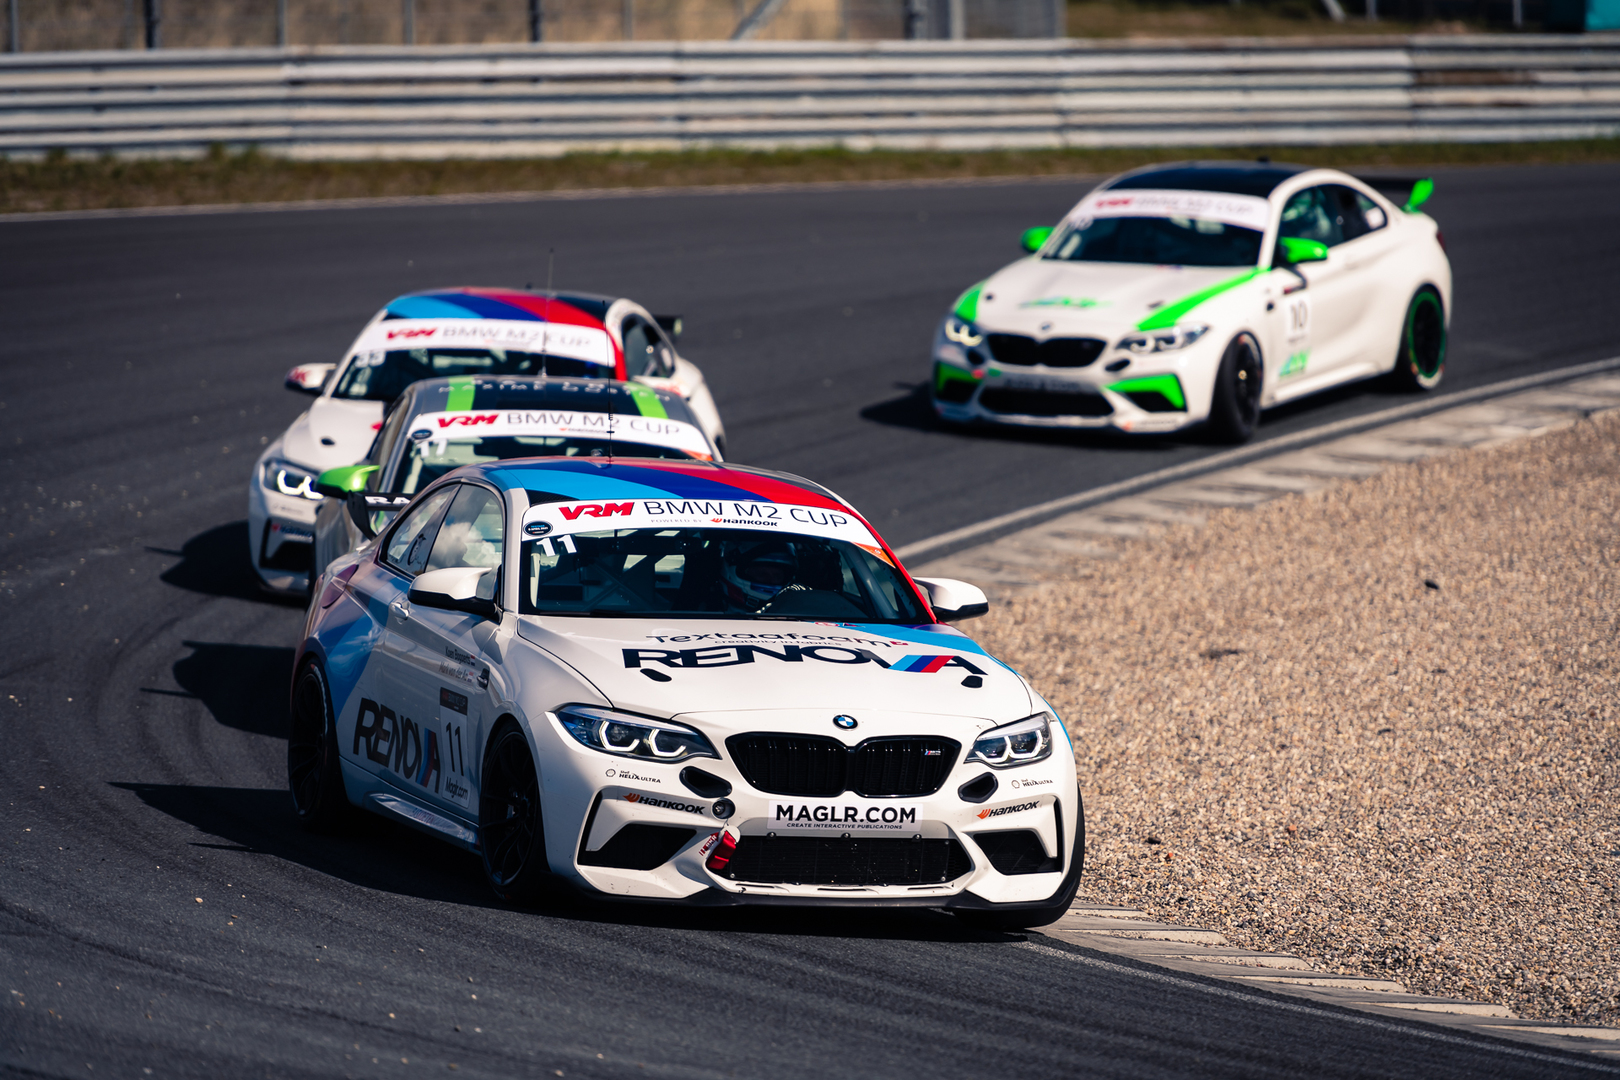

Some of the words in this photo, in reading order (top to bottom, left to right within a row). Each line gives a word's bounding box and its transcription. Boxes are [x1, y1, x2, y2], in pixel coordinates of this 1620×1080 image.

[442, 327, 501, 340] BMW
[546, 331, 592, 347] CUP
[437, 414, 499, 428] VRM
[507, 412, 574, 425] BMW
[583, 414, 621, 430] M2
[630, 418, 680, 435] CUP
[558, 502, 635, 520] VRM
[644, 501, 723, 515] BMW
[734, 503, 782, 520] M2
[789, 508, 848, 527] CUP
[536, 534, 578, 557] 11
[622, 645, 989, 675] RENOVA
[353, 697, 440, 794] RENOVA
[446, 722, 464, 777] 11
[619, 772, 640, 780] HELIX
[775, 804, 916, 824] MAGLR.COM
